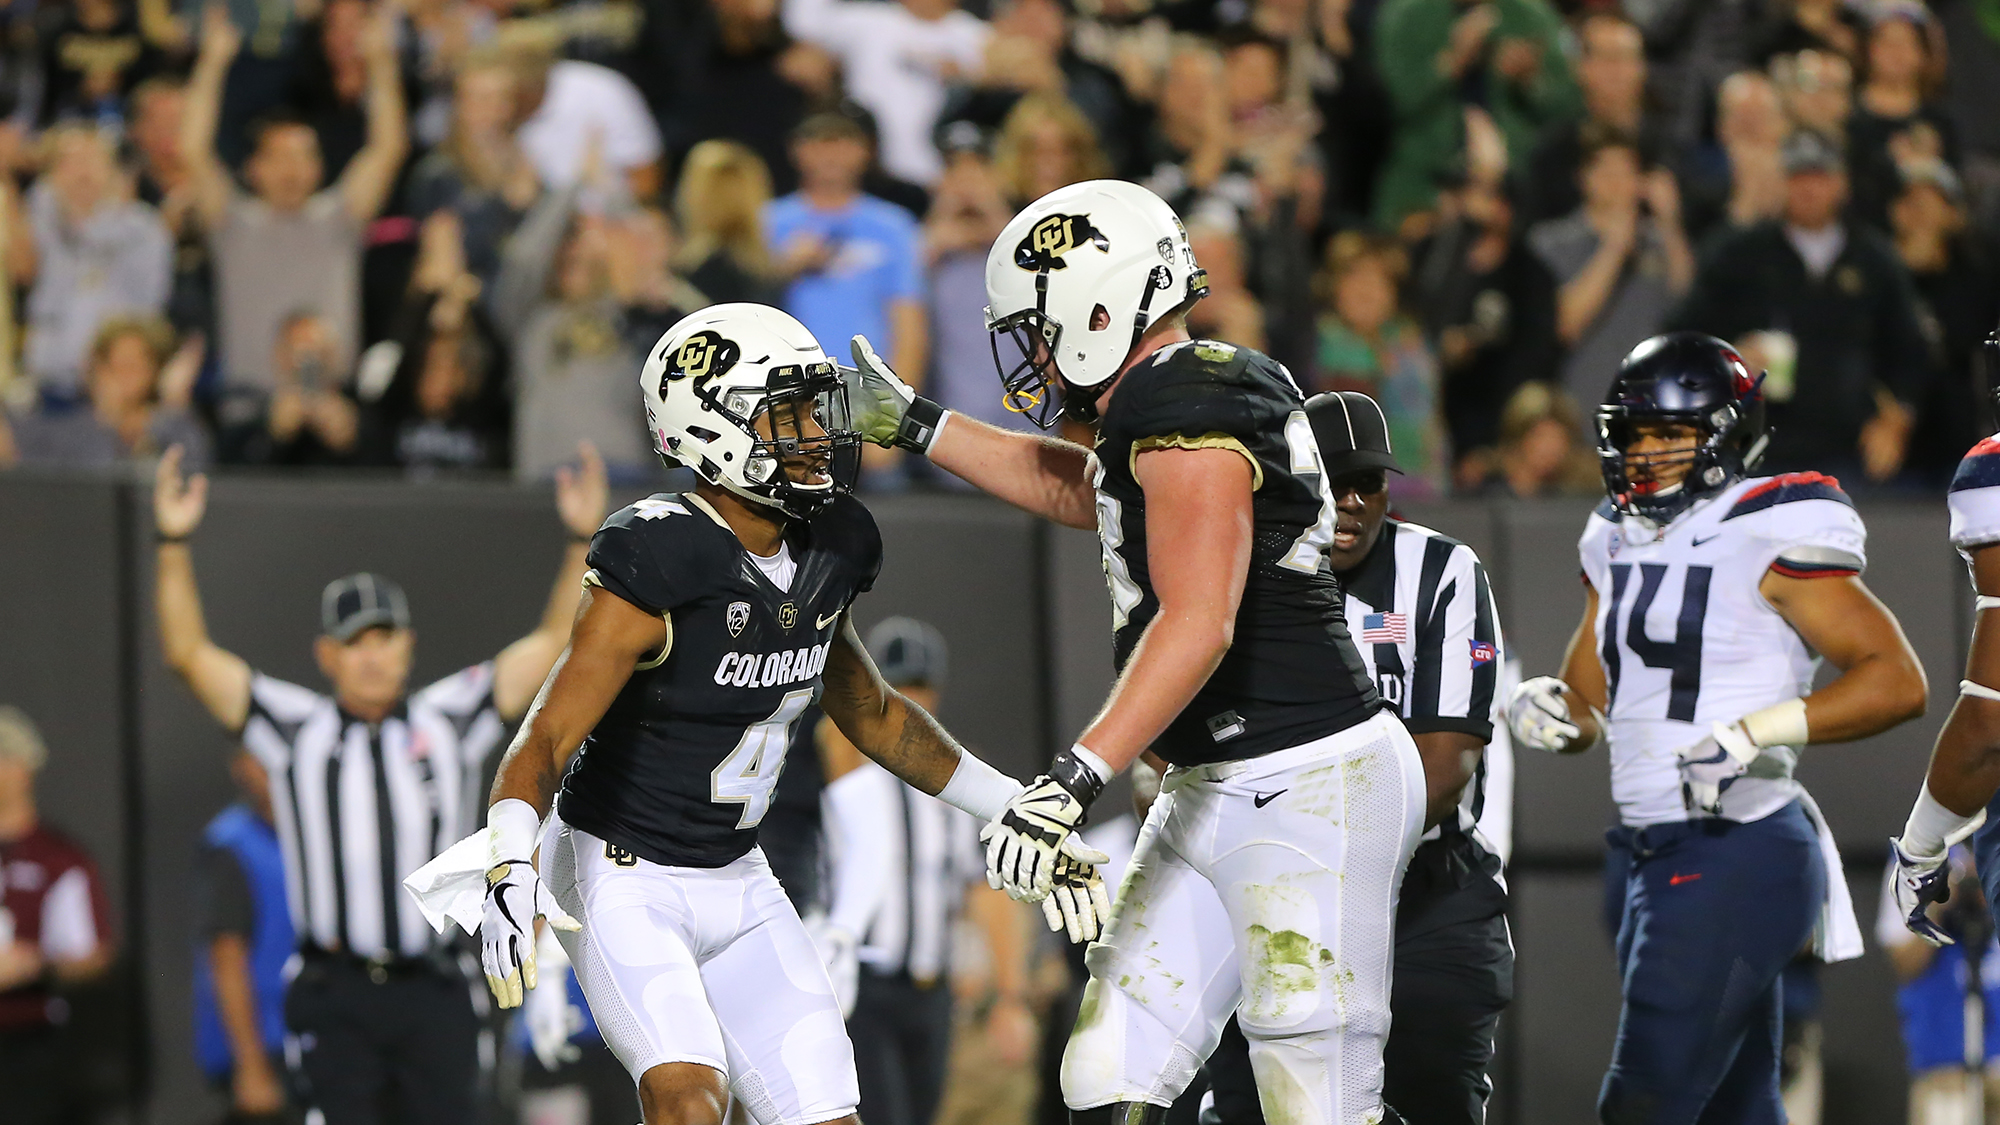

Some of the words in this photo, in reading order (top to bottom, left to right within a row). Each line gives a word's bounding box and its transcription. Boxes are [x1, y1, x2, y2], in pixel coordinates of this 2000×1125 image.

[1033, 216, 1074, 256] CU
[676, 335, 717, 377] CU
[778, 366, 794, 377] NIKE
[713, 640, 831, 688] COLORADO
[1602, 563, 1713, 723] 14
[710, 686, 814, 830] 4
